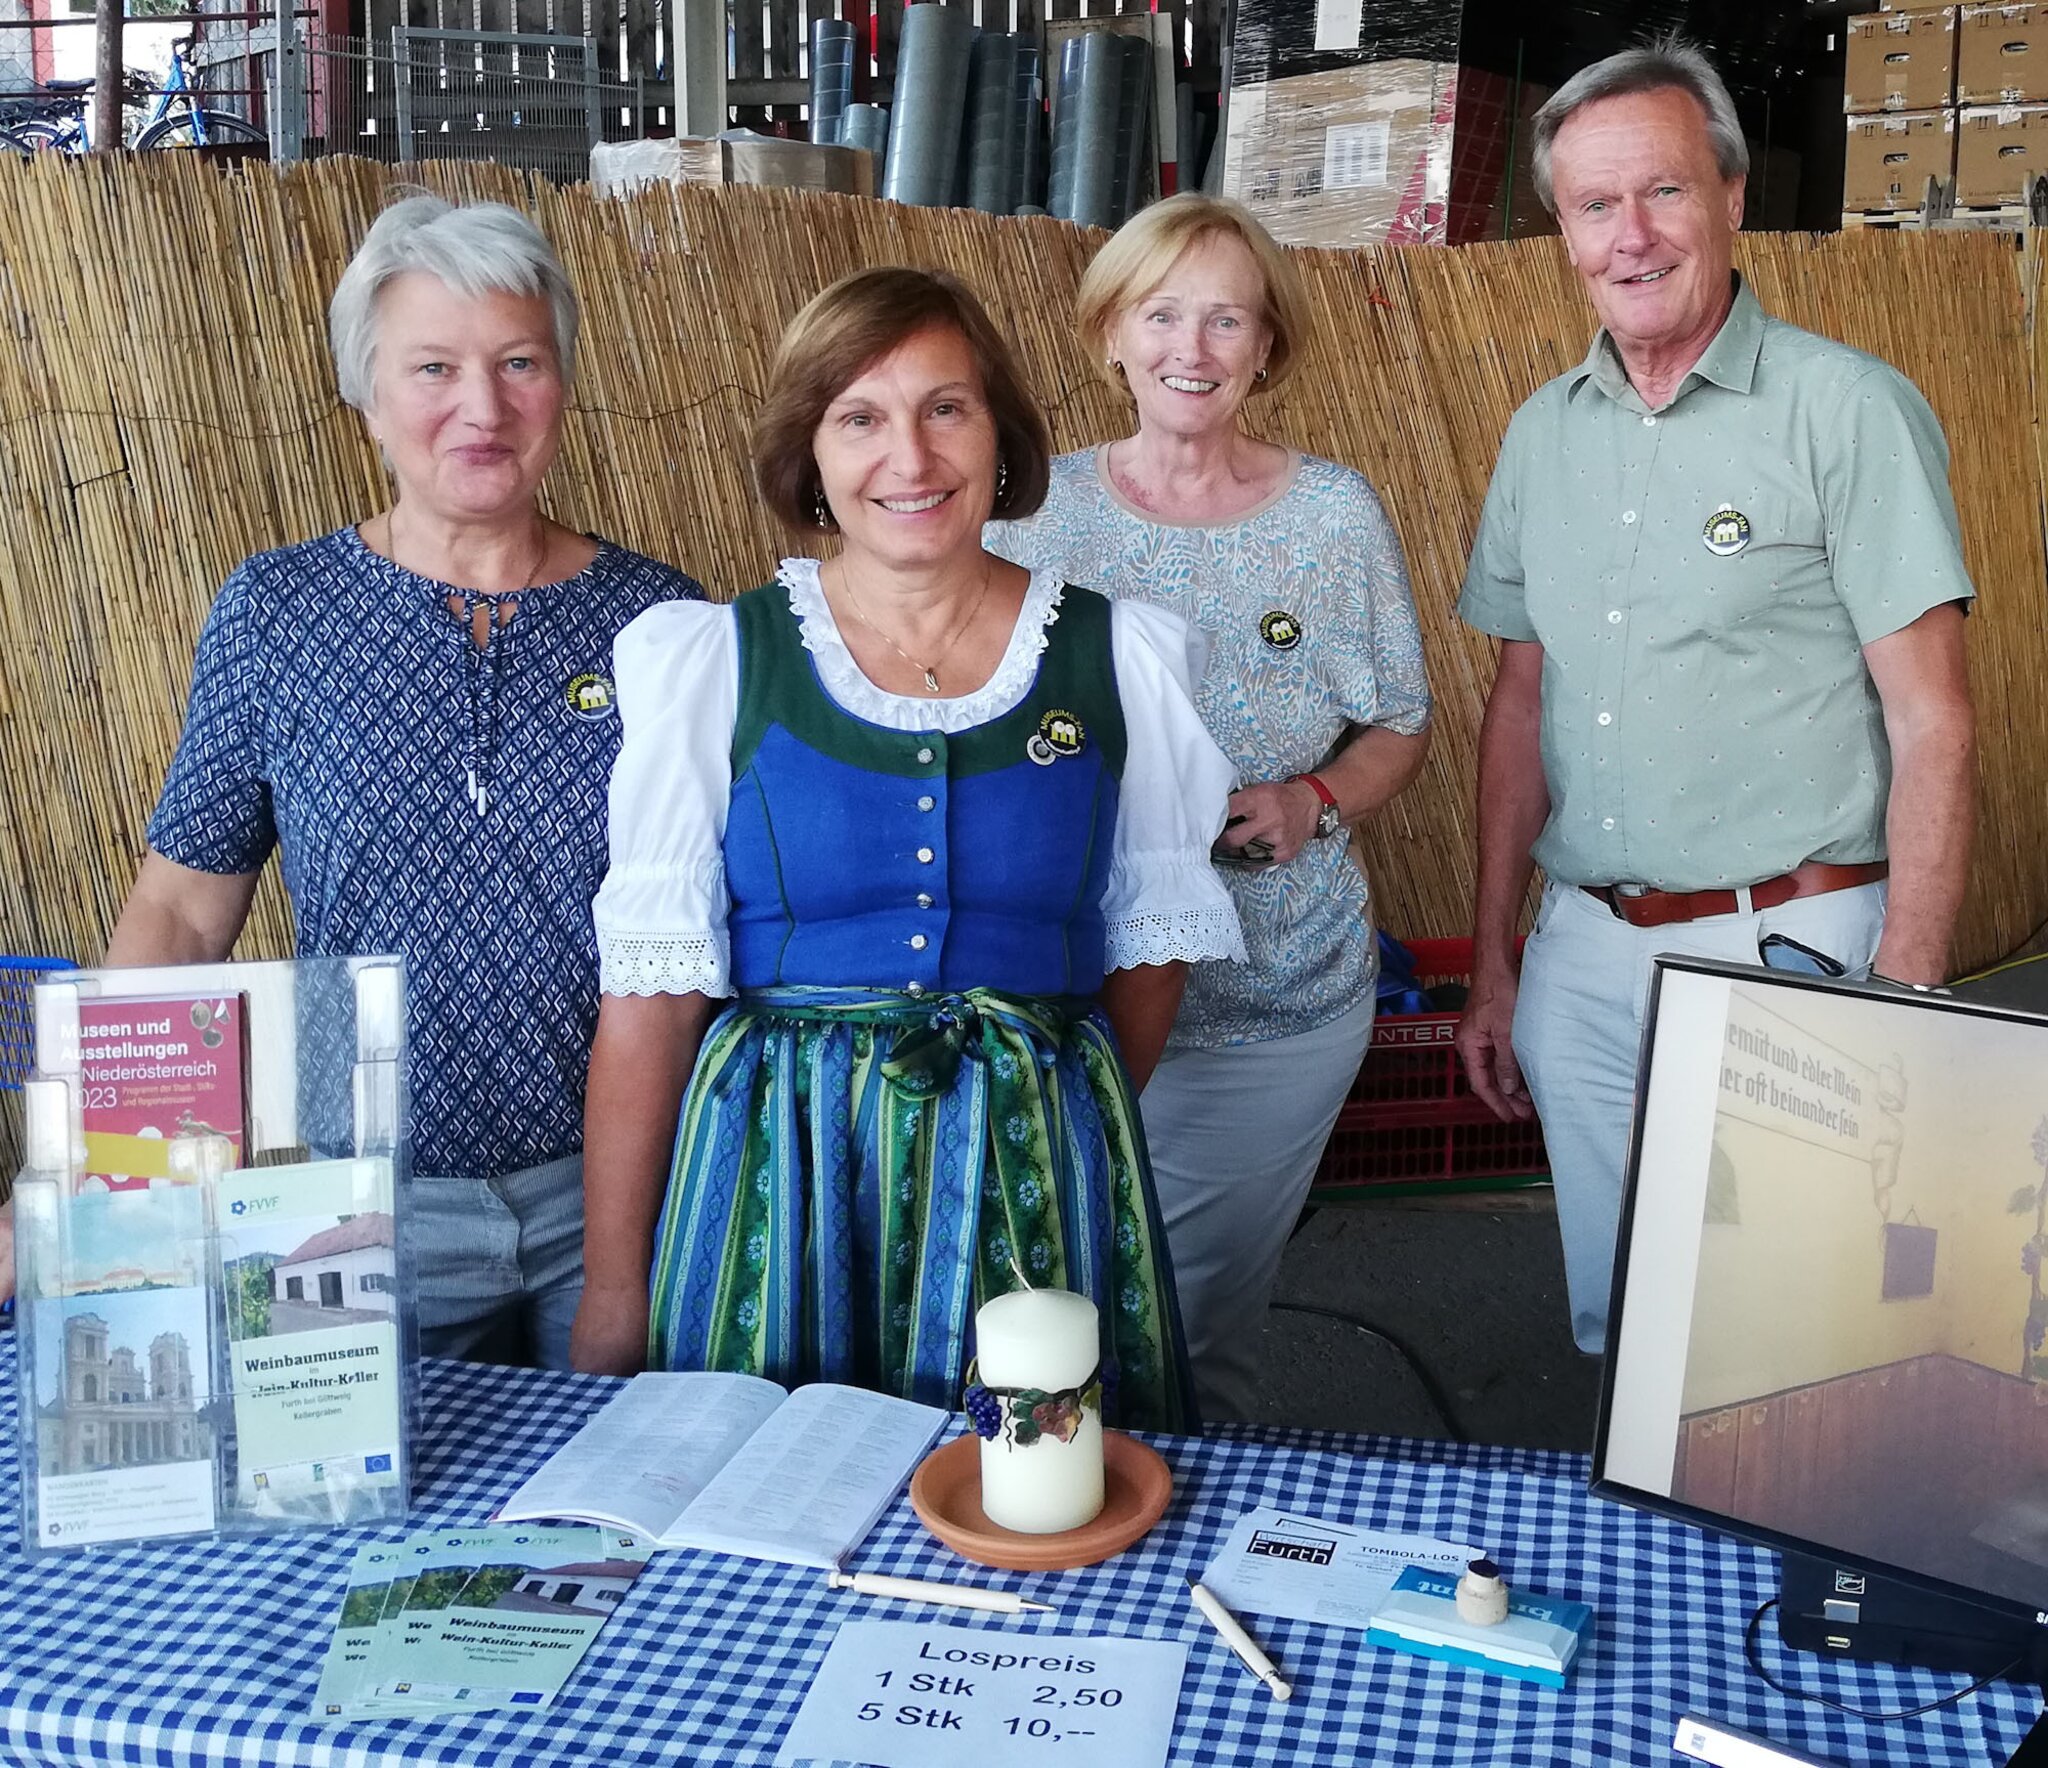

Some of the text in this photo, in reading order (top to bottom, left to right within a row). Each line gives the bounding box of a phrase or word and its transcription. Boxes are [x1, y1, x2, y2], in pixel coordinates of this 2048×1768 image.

[60, 1018, 170, 1039] Museen und
[60, 1041, 188, 1061] Ausstellungen
[82, 1060, 217, 1082] Niederösterreich
[1725, 1023, 1861, 1106] emüt und edler Wein
[75, 1086, 118, 1109] 023
[1745, 1071, 1768, 1105] oft
[244, 1346, 380, 1373] Weinbaumuseum
[1249, 1540, 1329, 1565] Furth
[1360, 1545, 1460, 1563] TOMBOLA-LOS
[449, 1617, 586, 1636] Weinbaumuseum
[440, 1632, 574, 1650] Wein-Kultur-Keller
[919, 1641, 1097, 1674] Lospreis
[874, 1670, 1124, 1709] 1 Stk 2,50
[856, 1702, 885, 1721] 5
[894, 1705, 964, 1731] Stk
